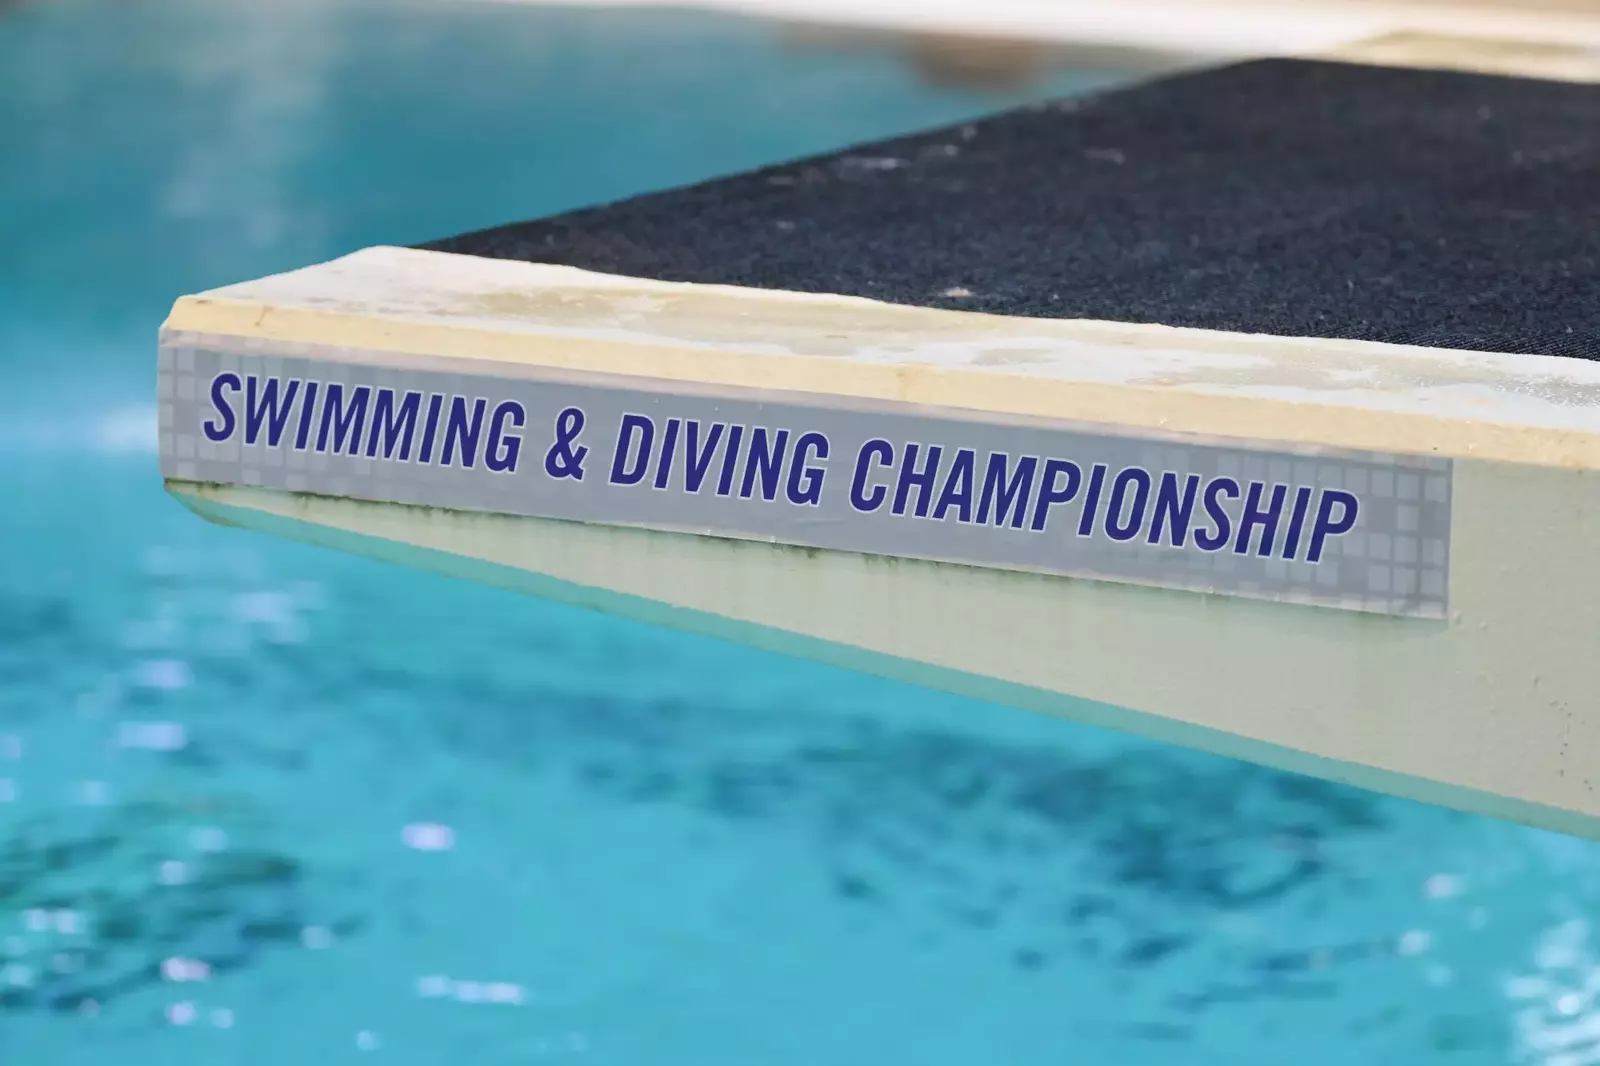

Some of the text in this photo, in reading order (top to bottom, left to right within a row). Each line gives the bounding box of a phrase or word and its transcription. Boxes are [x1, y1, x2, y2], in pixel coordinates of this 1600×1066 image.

[203, 373, 1358, 562] SWIMMING & DIVING CHAMPIONSHIP
